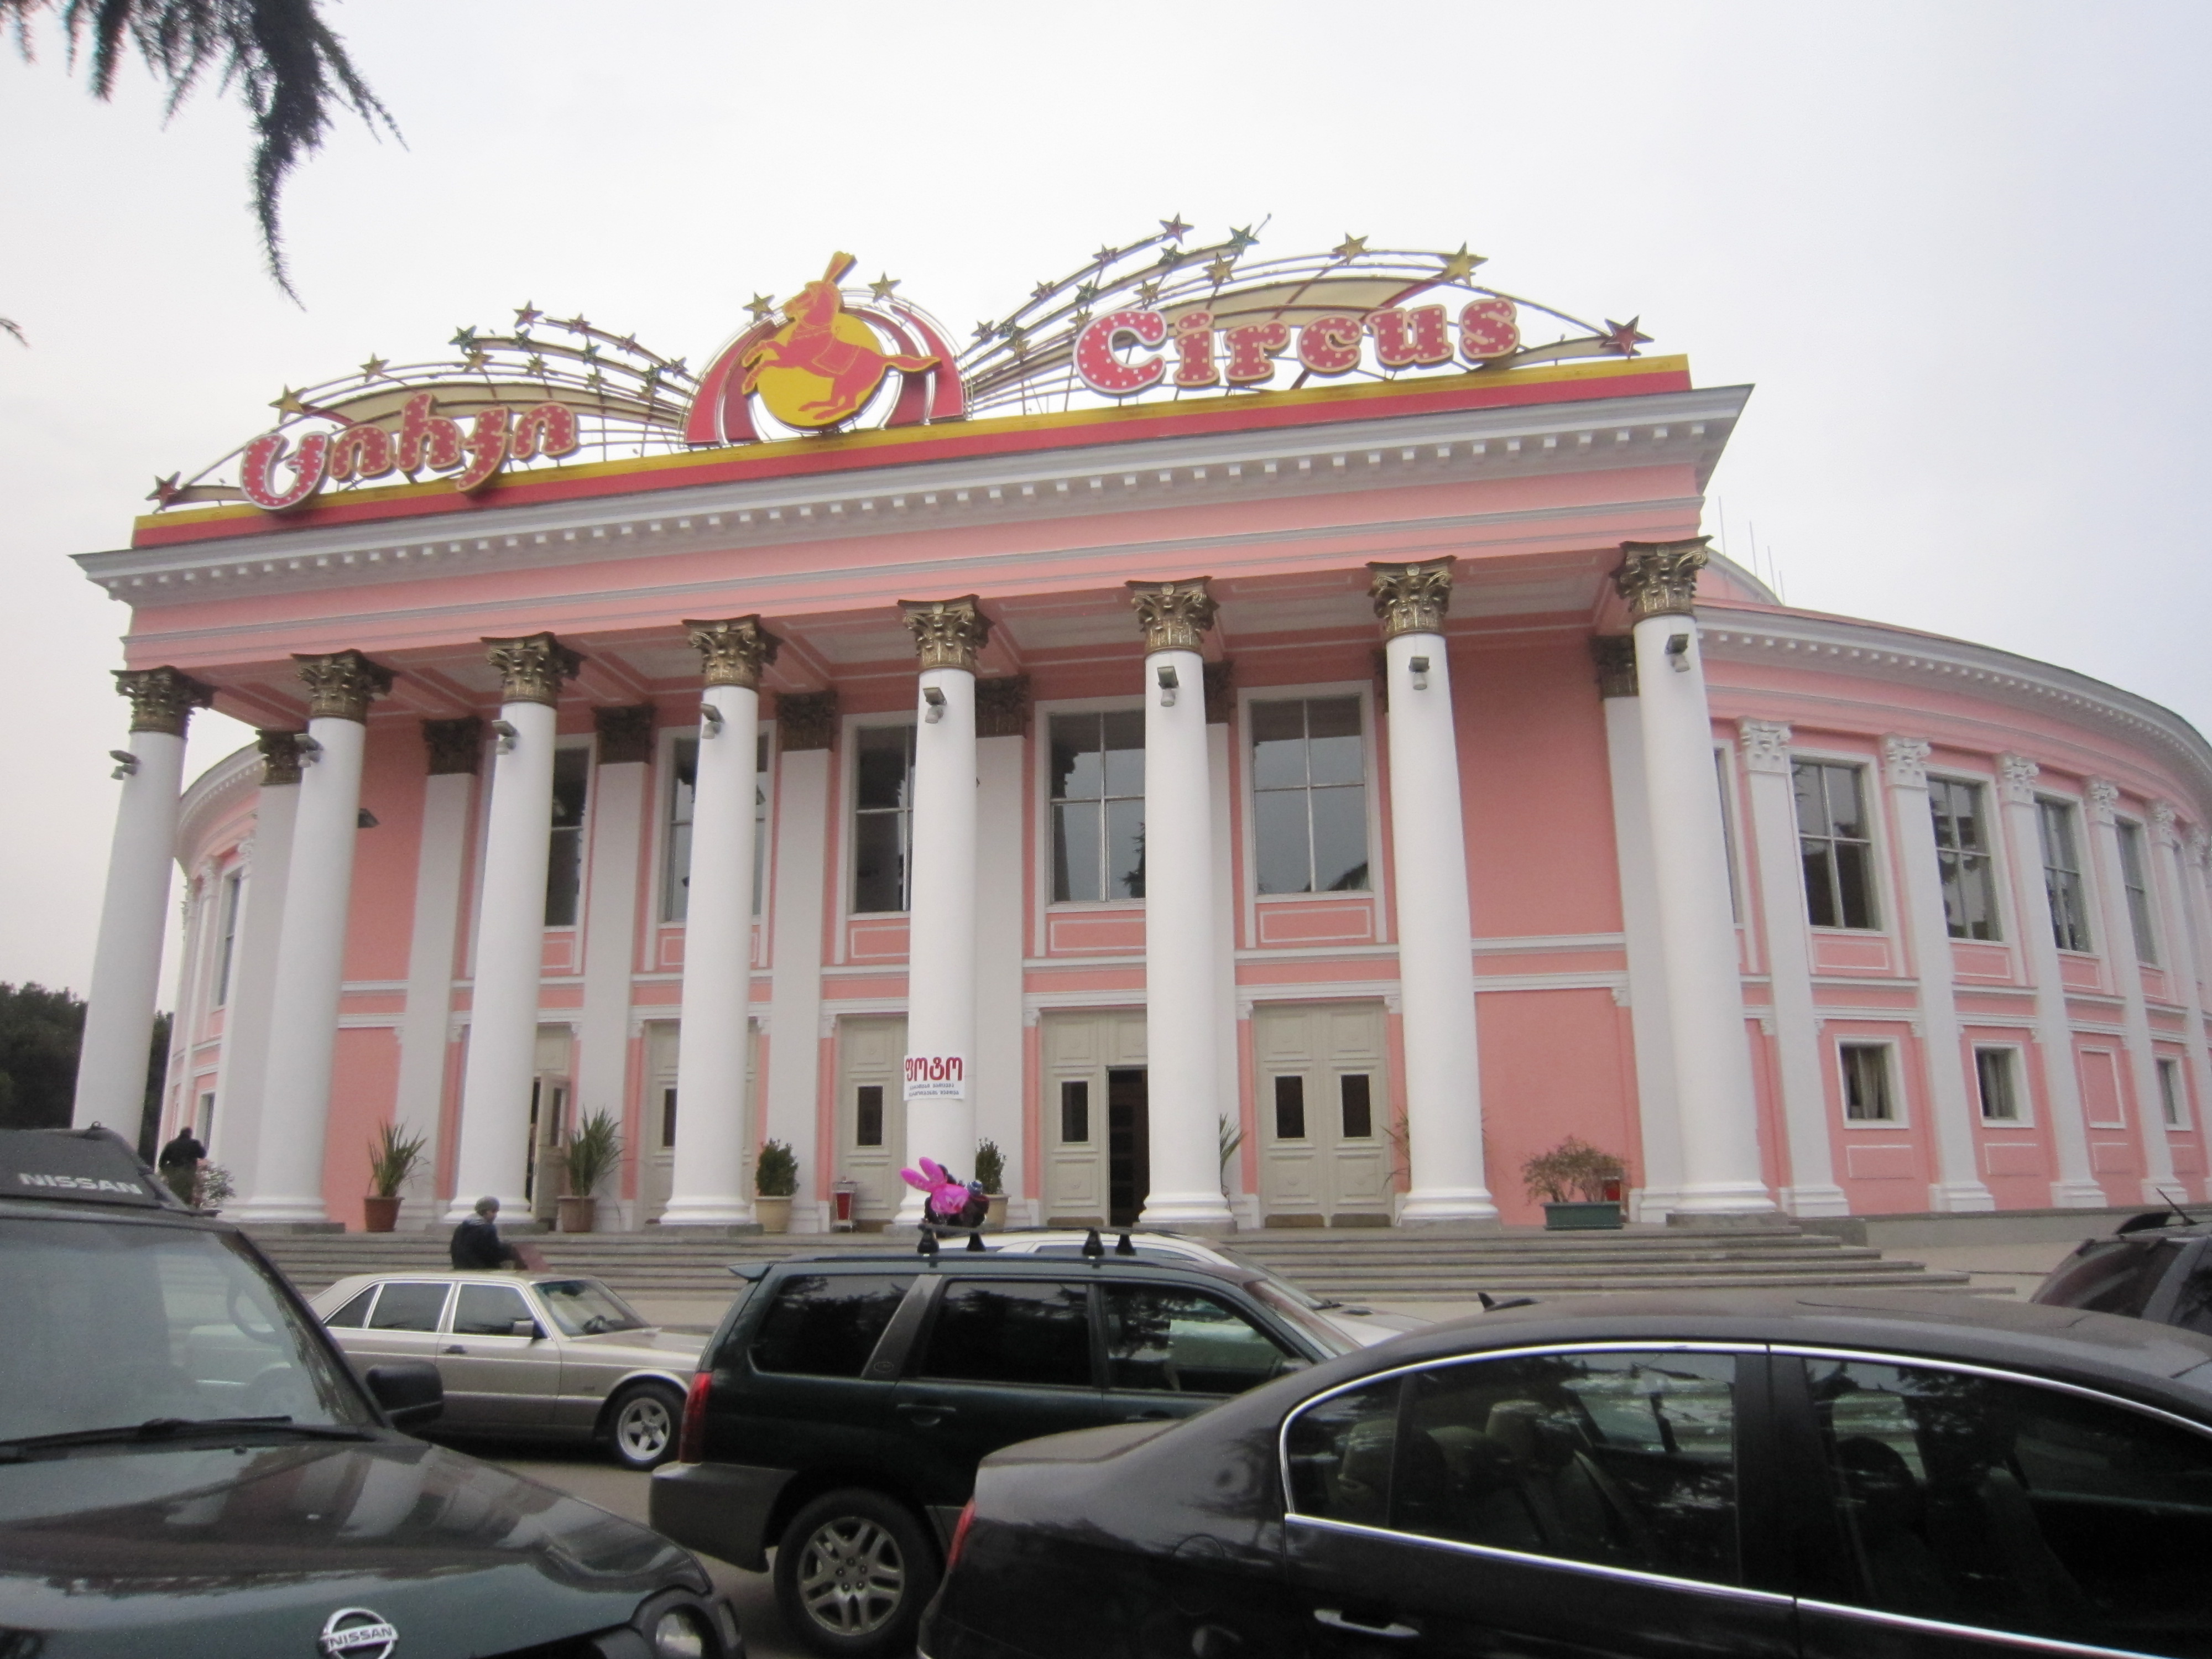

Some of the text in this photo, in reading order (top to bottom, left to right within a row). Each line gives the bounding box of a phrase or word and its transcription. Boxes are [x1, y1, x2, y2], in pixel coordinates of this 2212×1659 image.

[1073, 297, 1521, 394] Circus
[239, 392, 578, 510] ცირკი
[905, 1057, 963, 1082] ფოტო
[18, 1173, 143, 1194] NISSAN
[330, 1626, 393, 1647] NISSAN
